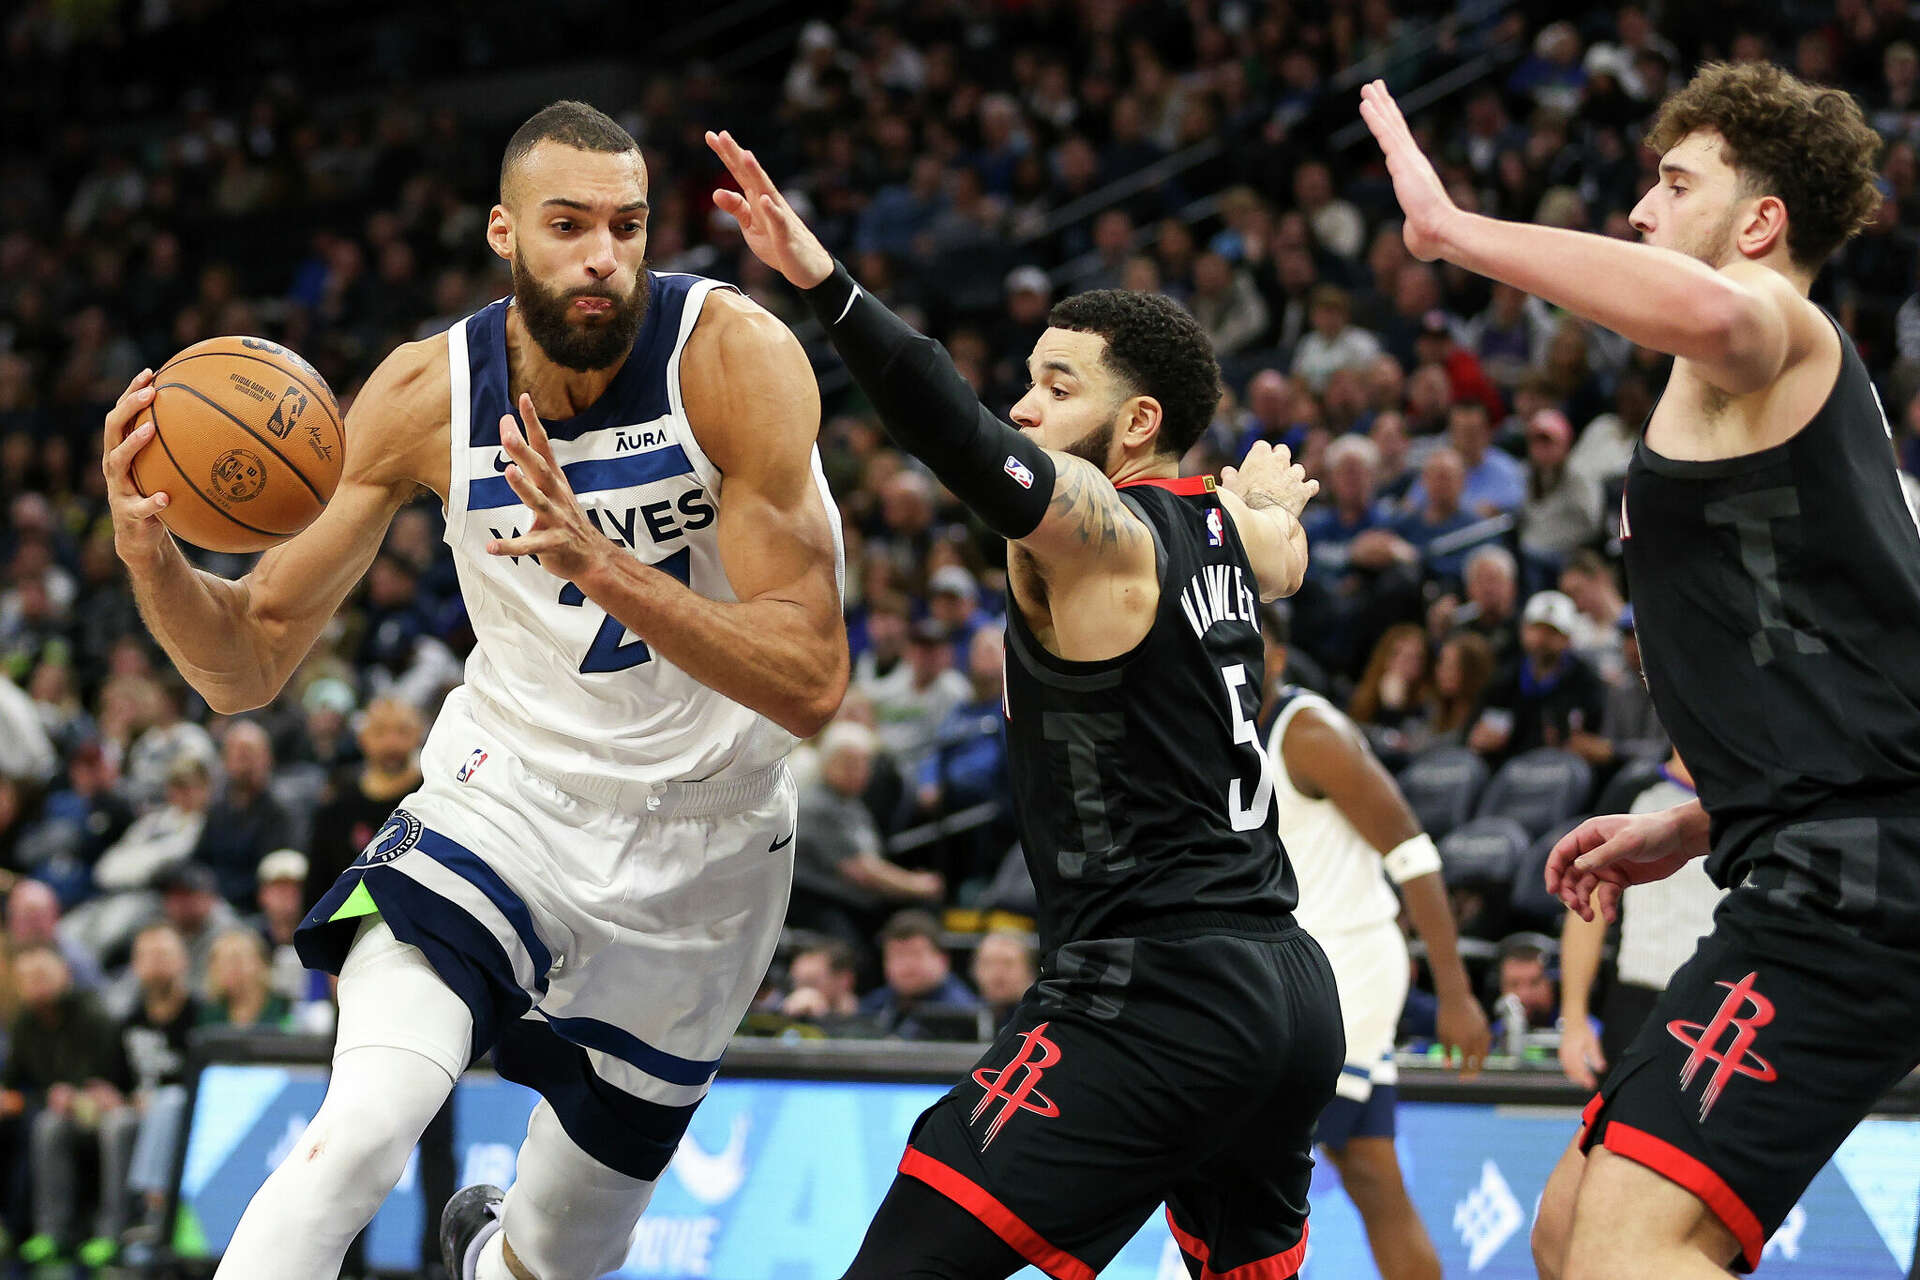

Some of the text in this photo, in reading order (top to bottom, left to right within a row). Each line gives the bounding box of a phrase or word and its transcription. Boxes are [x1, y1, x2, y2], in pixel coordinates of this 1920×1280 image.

[489, 488, 715, 567] WLVES
[558, 545, 691, 674] 2
[1221, 663, 1274, 832] 5
